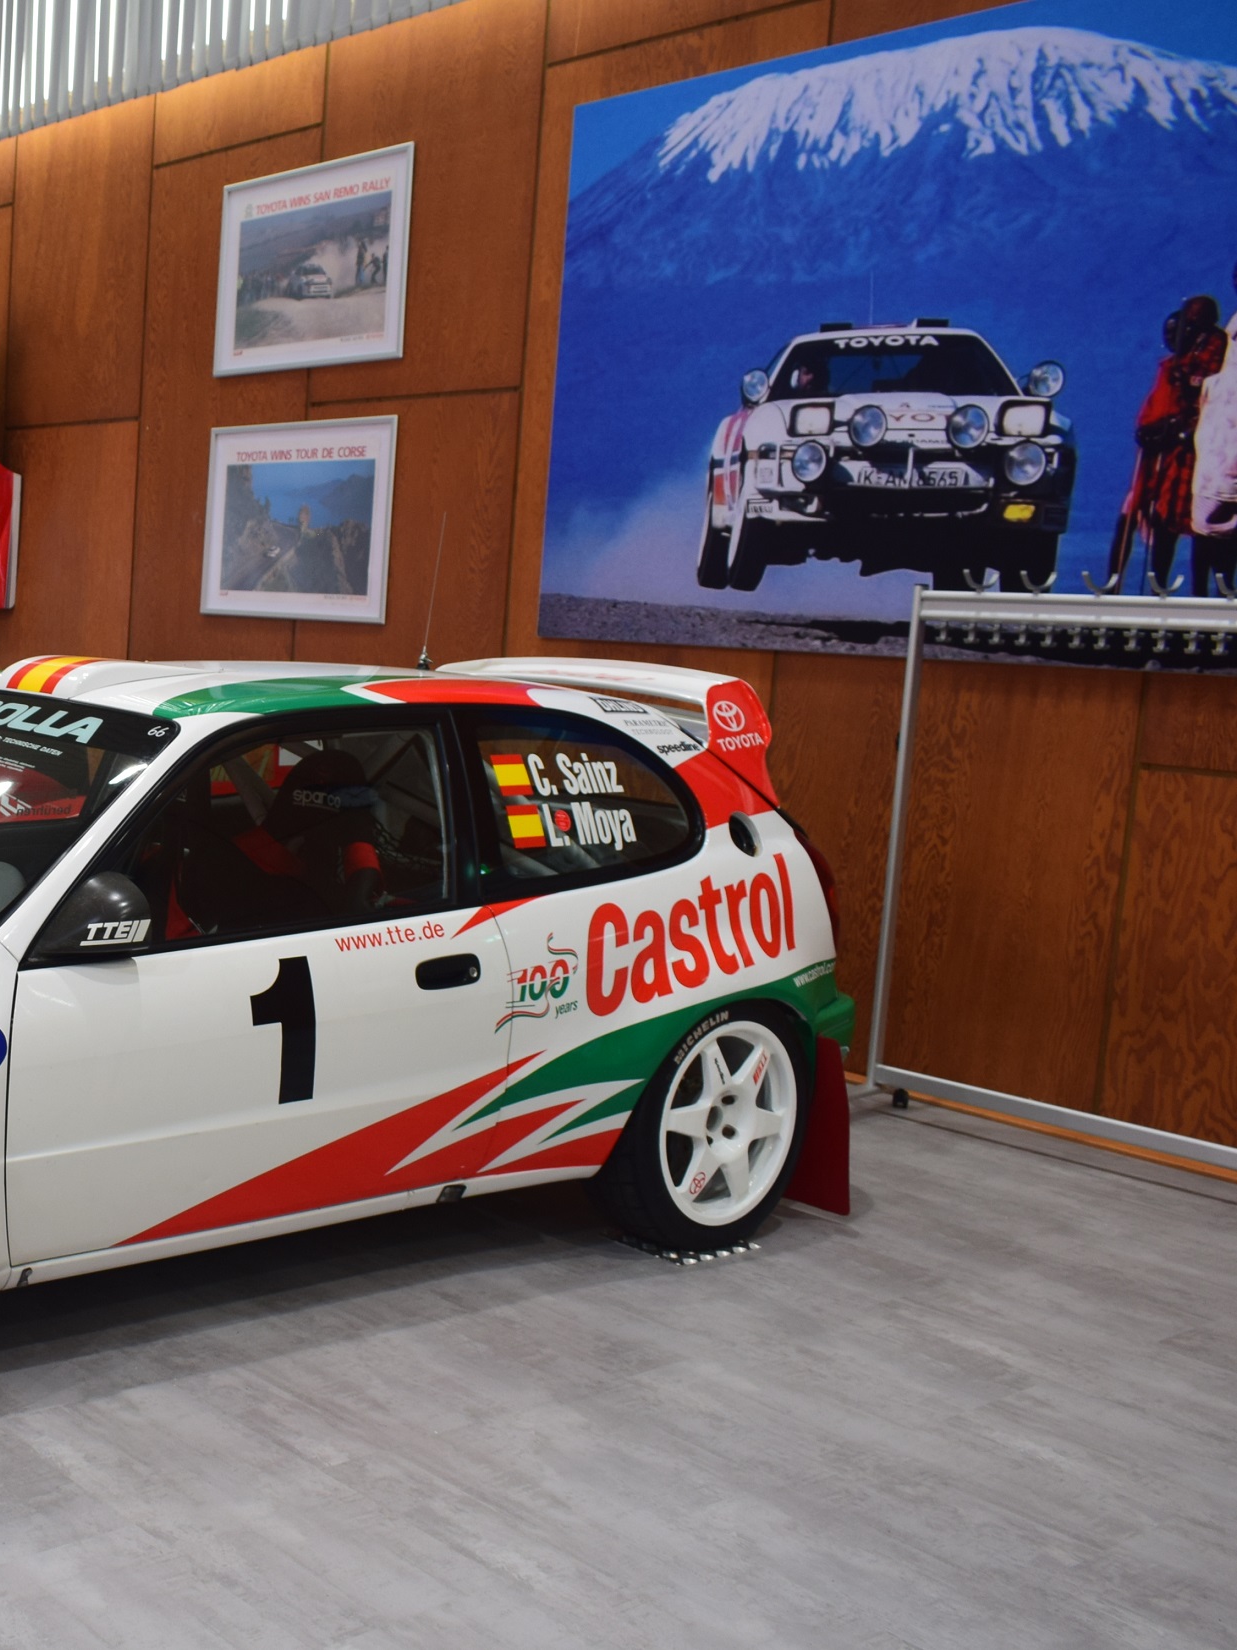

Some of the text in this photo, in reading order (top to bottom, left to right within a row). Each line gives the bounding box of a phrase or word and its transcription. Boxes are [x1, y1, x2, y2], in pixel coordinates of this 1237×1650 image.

[255, 176, 391, 215] TOYOTA WINS SAN REMO RALLY
[834, 334, 939, 350] TOYOTA
[236, 446, 368, 463] TOYOTA WINS TOUR DE CORSE
[148, 725, 166, 738] 66
[717, 732, 764, 752] TOYOTA
[3, 736, 42, 751] TECHNISCHE
[39, 745, 64, 757] DATEN
[656, 740, 701, 756] speedline
[528, 751, 624, 797] C. Sainz
[292, 789, 341, 809] sparco
[573, 804, 637, 853] Moya
[334, 920, 446, 953] www.tte.de
[586, 853, 796, 1018] Castrol
[516, 958, 570, 1003] 100
[554, 1000, 579, 1020] years
[249, 956, 317, 1105] 1
[673, 1010, 730, 1065] MICHELIN
